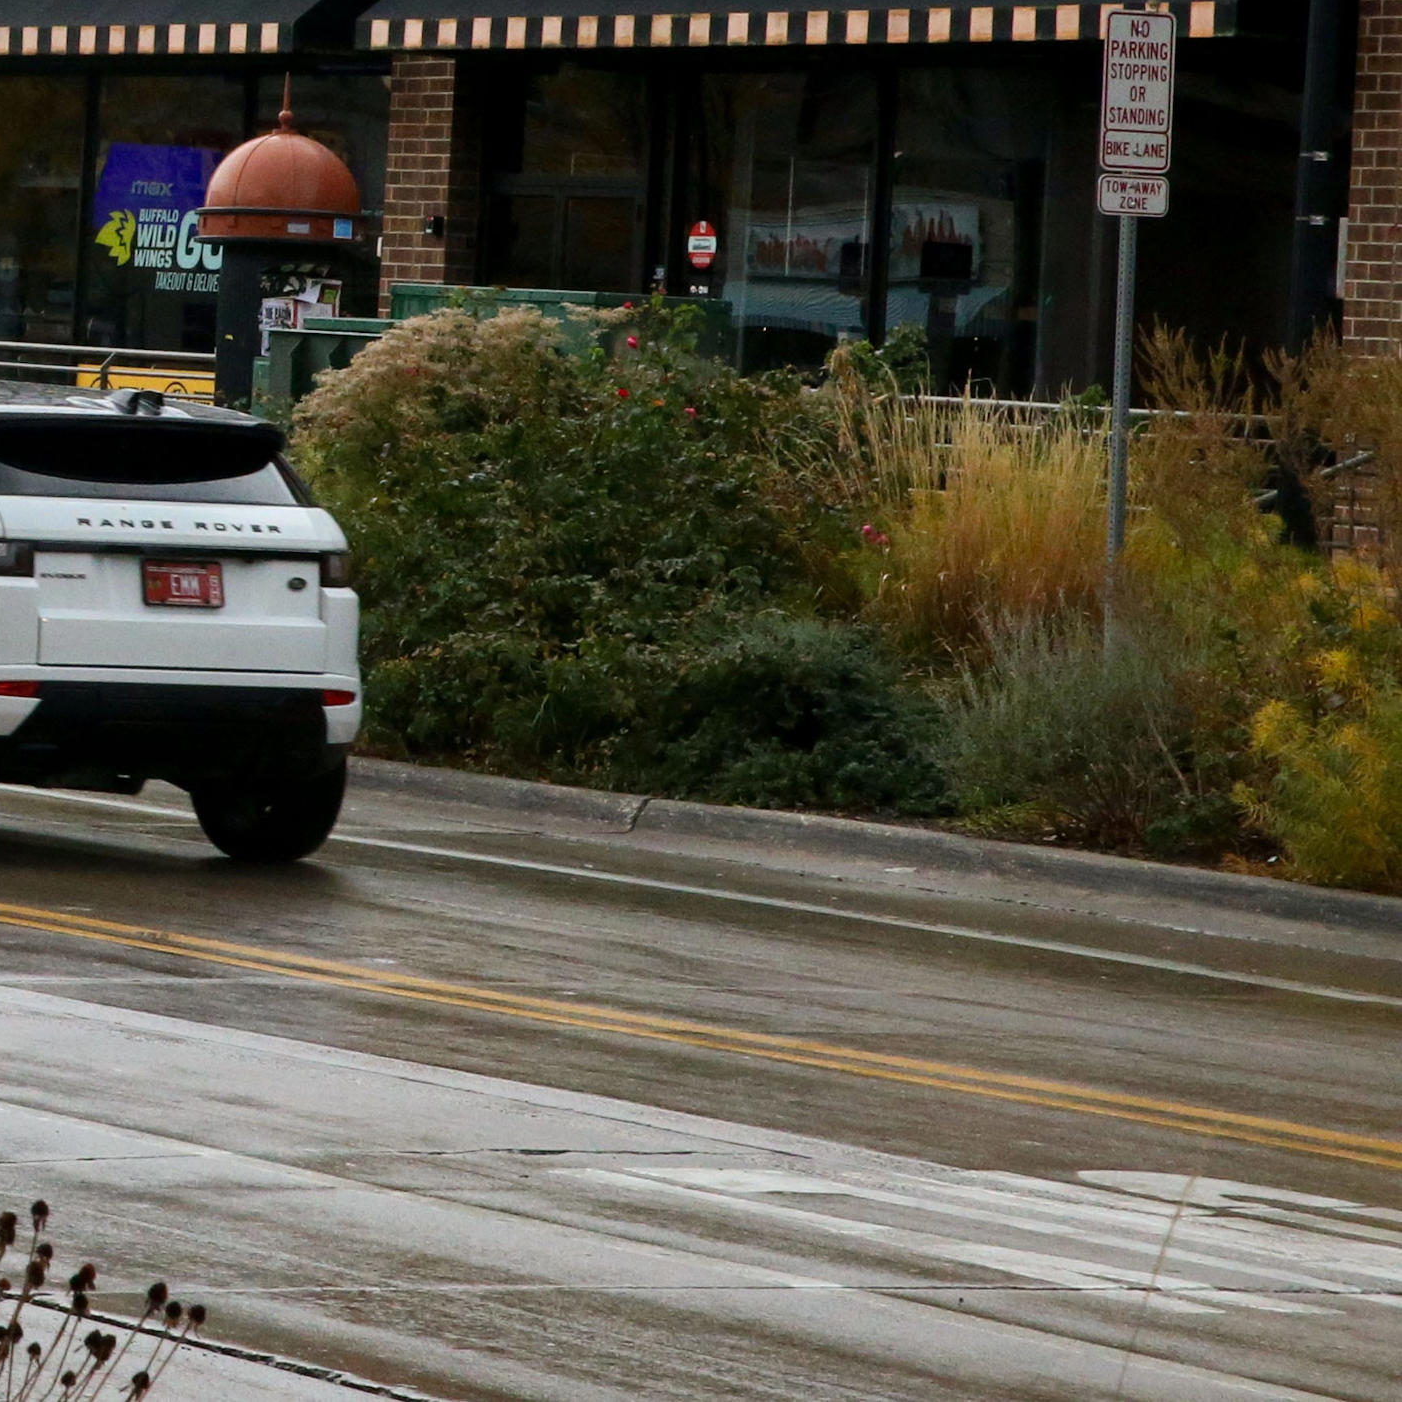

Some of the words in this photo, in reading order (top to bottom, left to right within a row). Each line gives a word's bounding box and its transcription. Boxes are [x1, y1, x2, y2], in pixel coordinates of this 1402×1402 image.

[1130, 19, 1151, 37] NO
[1110, 40, 1169, 61] PARKING
[1110, 62, 1168, 83] STOPPING
[1129, 85, 1146, 102] OR
[1108, 106, 1166, 126] STANDING
[1105, 139, 1130, 157] BIKE
[1134, 141, 1166, 159] LANE
[131, 180, 174, 196] max
[1119, 196, 1149, 211] ZONE
[139, 208, 179, 223] BUFFALO
[137, 223, 178, 249] WILD
[133, 249, 174, 269] WINGS
[155, 271, 186, 290] TAKEOUT
[77, 517, 175, 530] RANGE
[195, 521, 282, 534] ROVER
